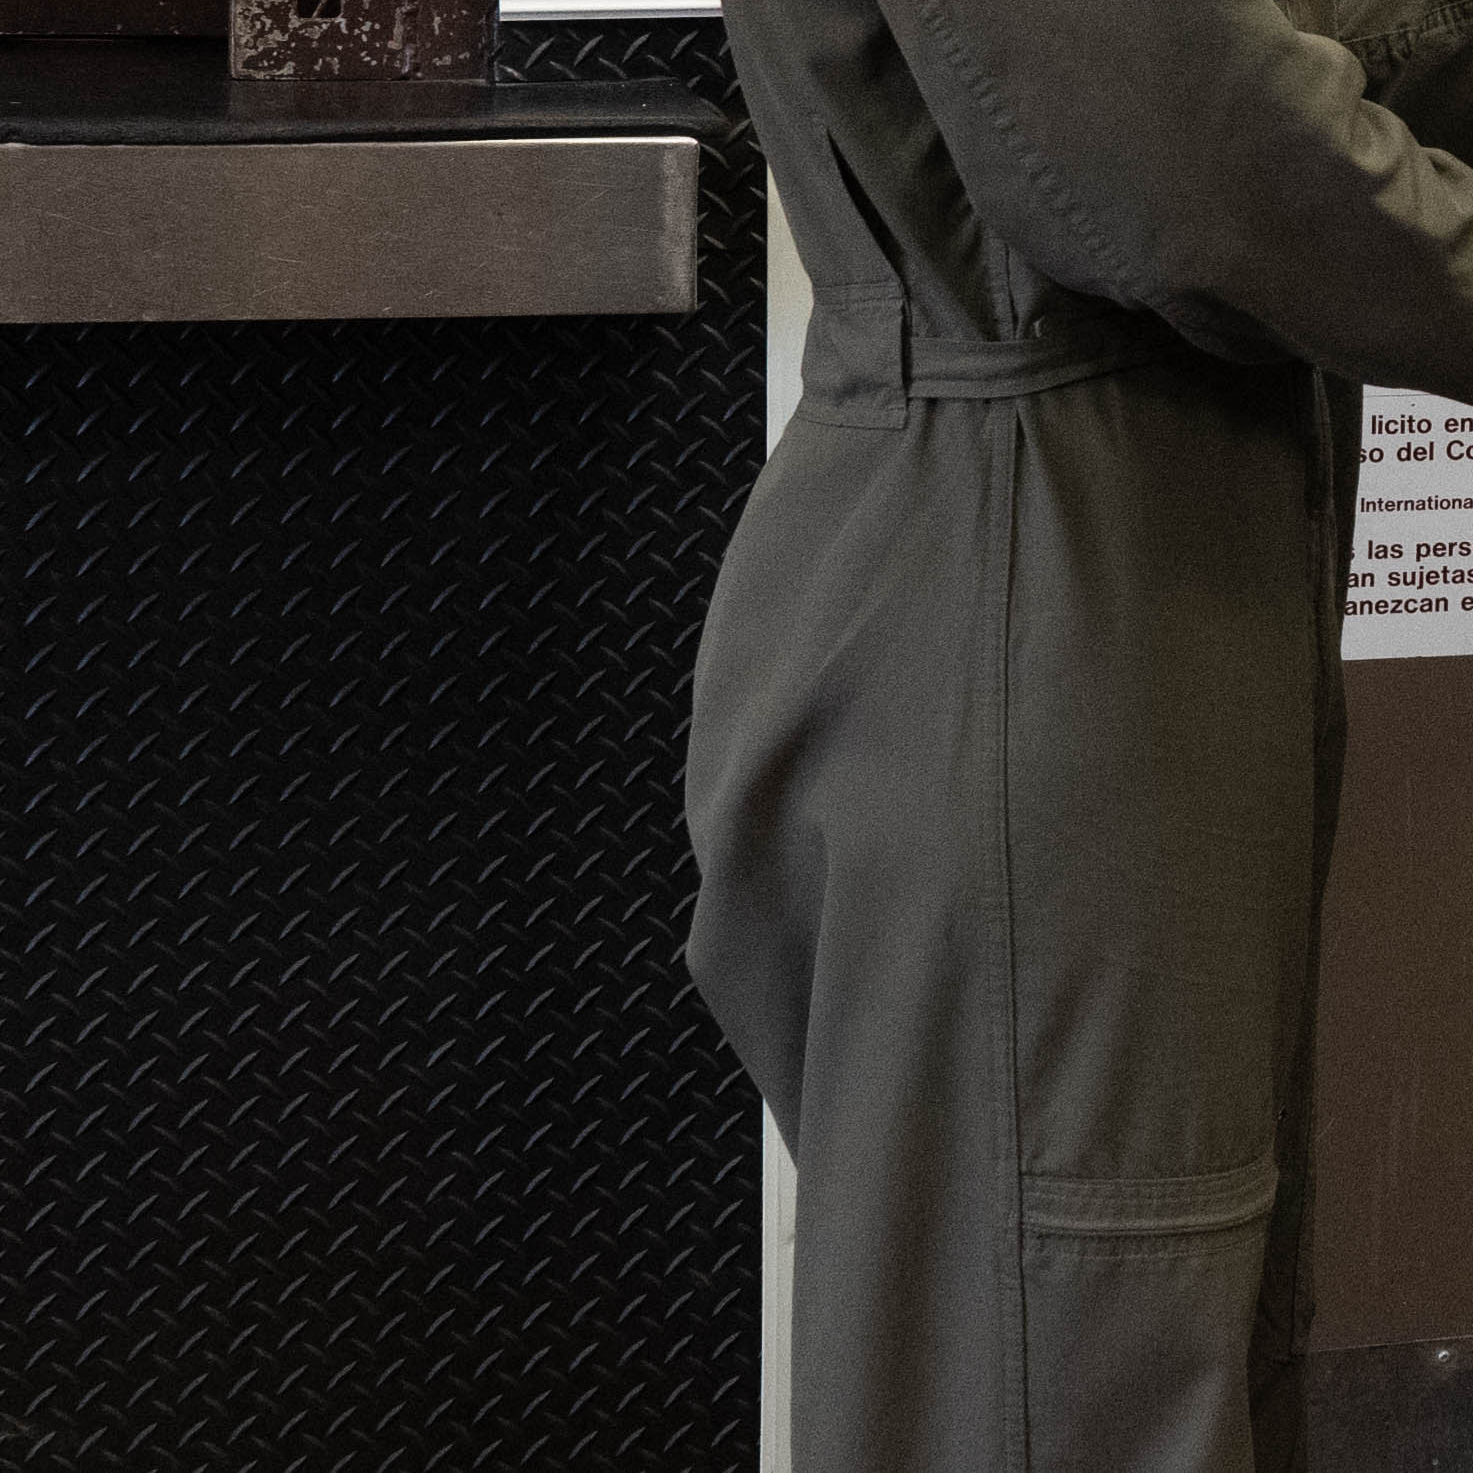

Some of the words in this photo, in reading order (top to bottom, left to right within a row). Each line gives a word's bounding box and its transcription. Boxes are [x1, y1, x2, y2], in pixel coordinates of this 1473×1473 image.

[1396, 440, 1435, 463] del
[1367, 539, 1404, 560] las
[1343, 595, 1449, 617] anezcan
